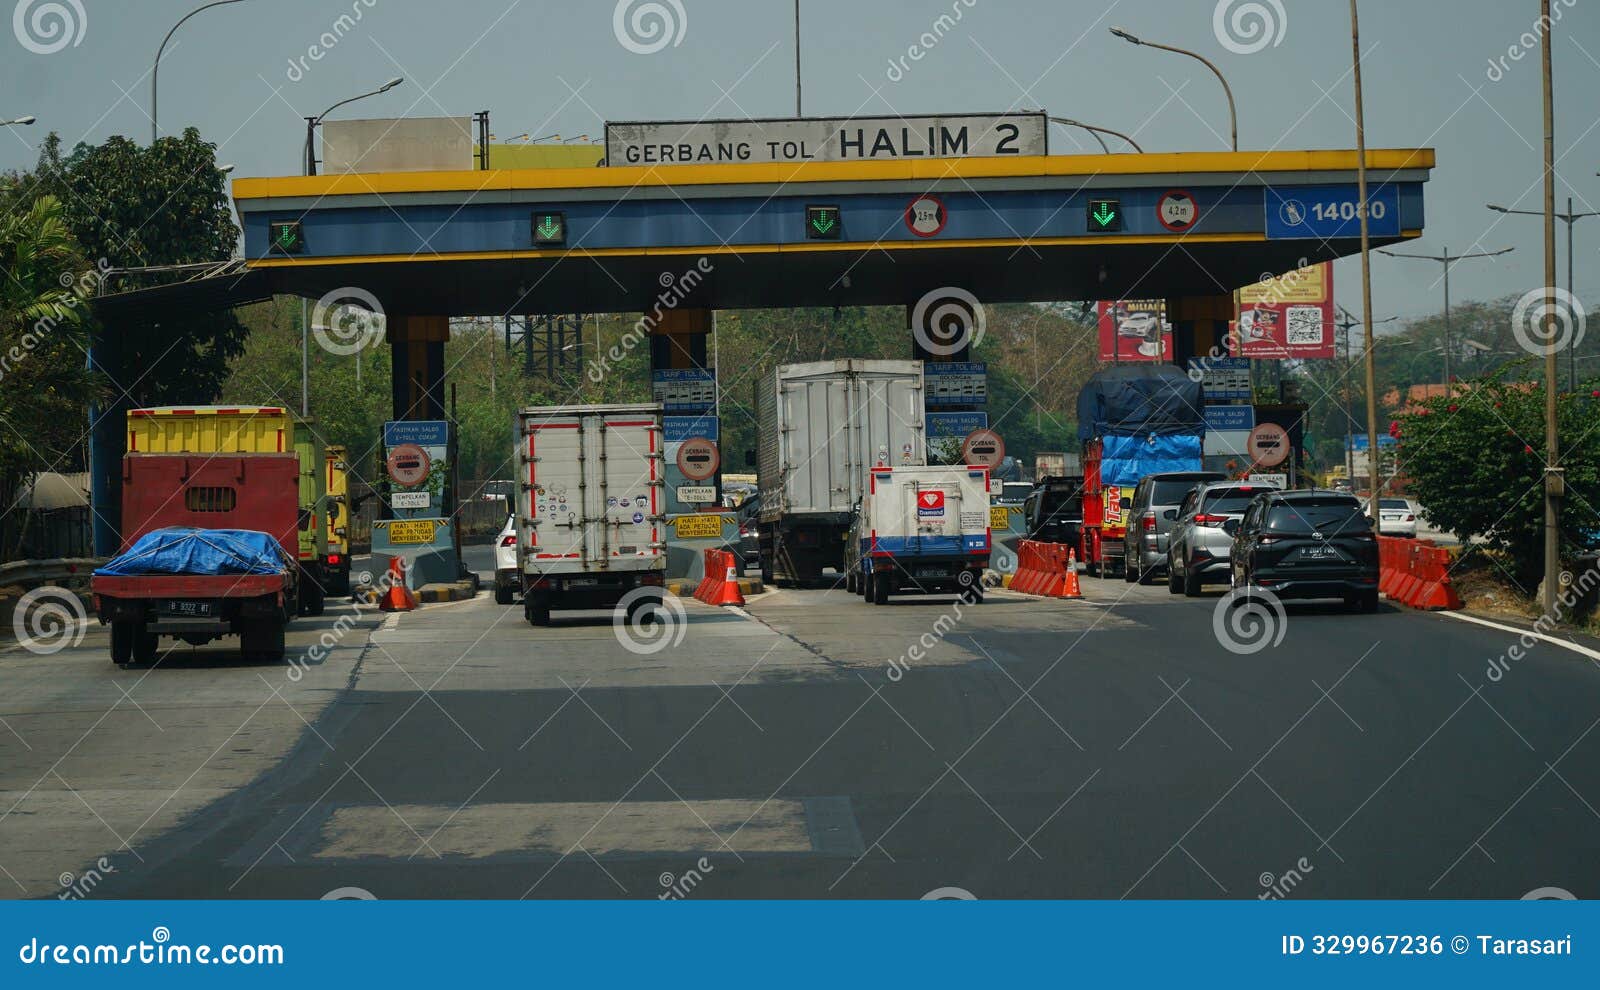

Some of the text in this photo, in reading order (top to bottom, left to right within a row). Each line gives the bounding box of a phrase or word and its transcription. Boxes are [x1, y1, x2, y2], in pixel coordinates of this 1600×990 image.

[626, 123, 1019, 163] GERBANG TOL HALIM 2
